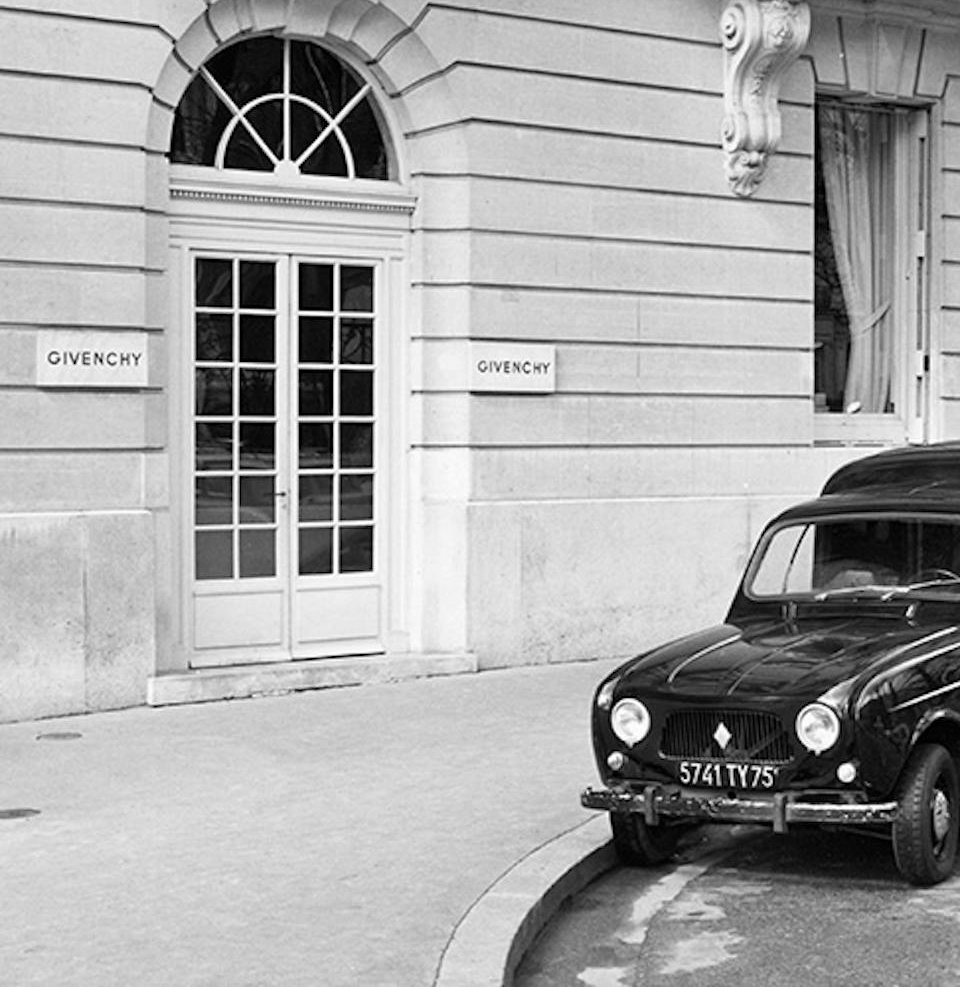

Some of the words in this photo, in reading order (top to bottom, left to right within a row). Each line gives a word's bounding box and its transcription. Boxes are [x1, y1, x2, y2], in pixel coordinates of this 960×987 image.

[47, 350, 142, 367] GIVENCHY
[477, 359, 551, 375] GIVENCHY
[680, 761, 722, 787] 5741
